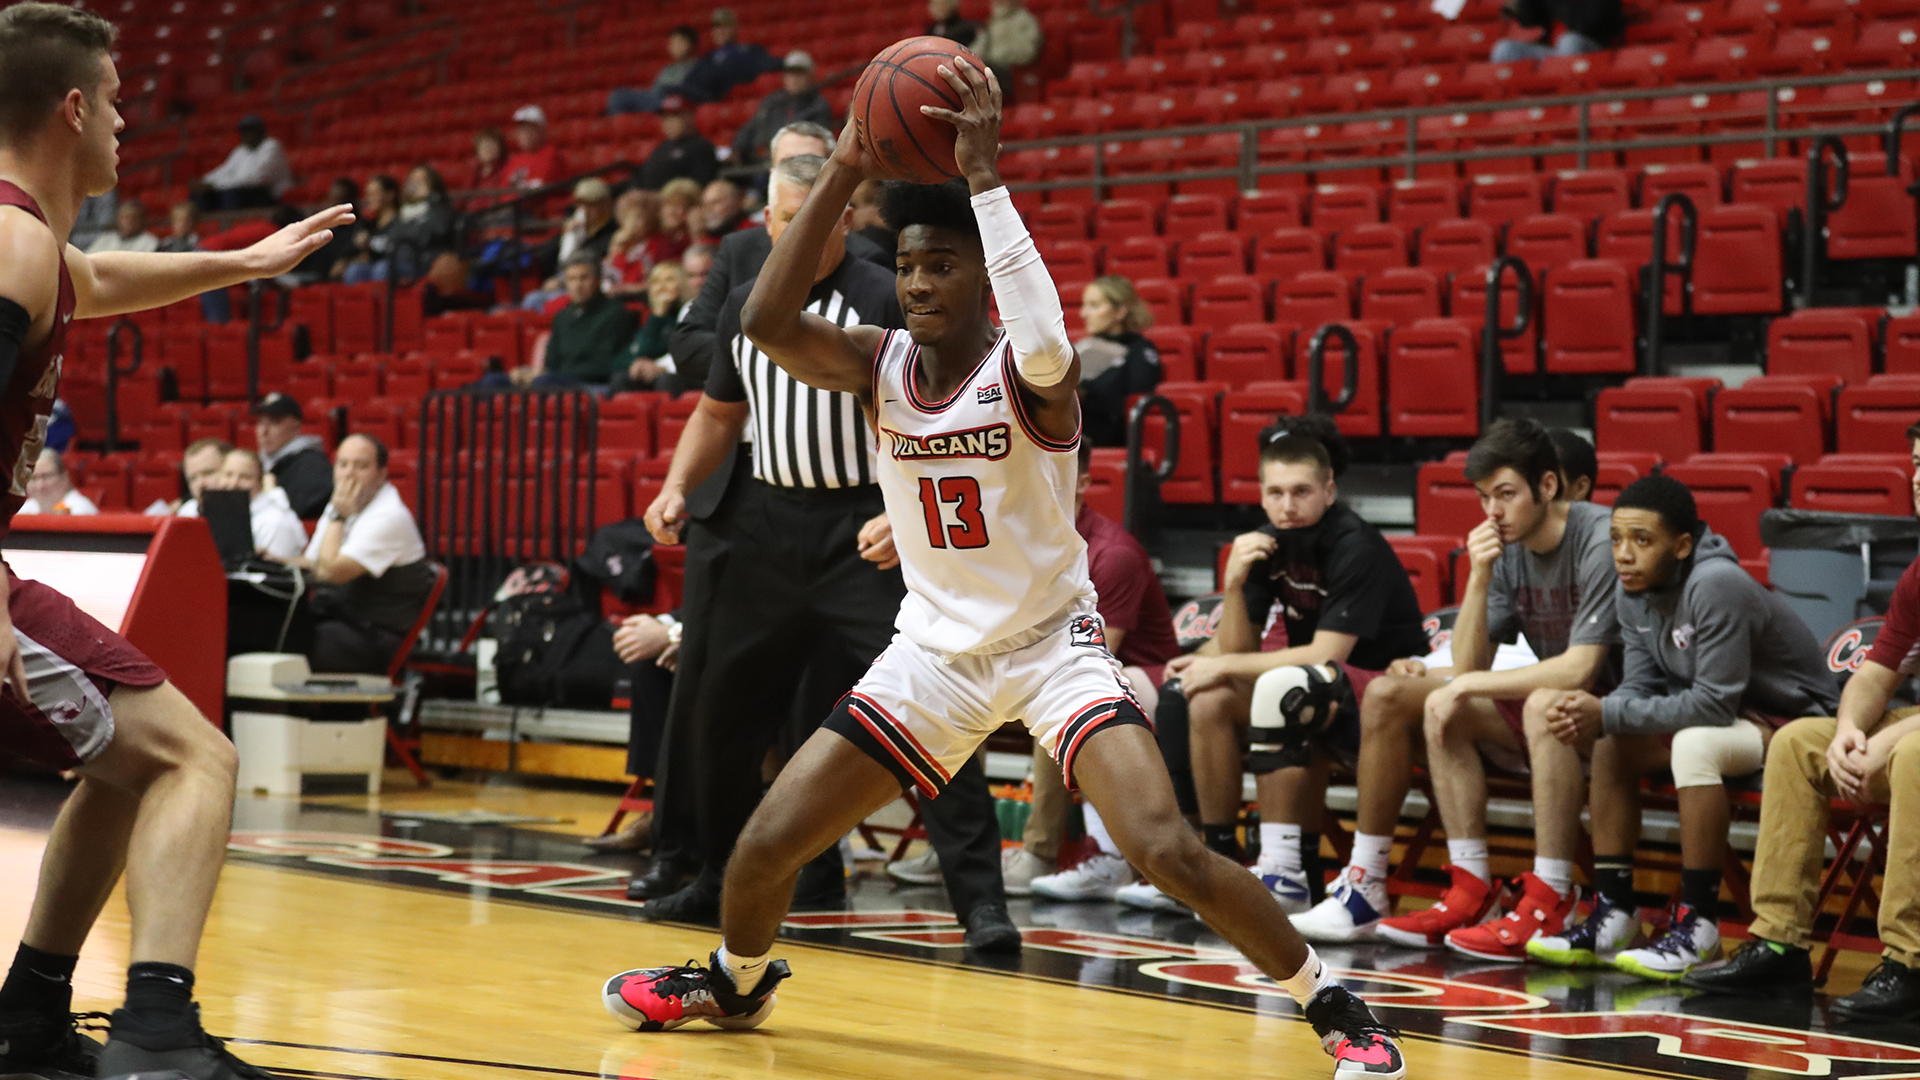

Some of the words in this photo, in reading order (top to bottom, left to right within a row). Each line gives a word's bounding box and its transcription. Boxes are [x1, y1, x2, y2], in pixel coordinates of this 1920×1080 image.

[884, 425, 1010, 460] VULCANS
[917, 475, 990, 550] 13
[1827, 628, 1874, 673] Ca
